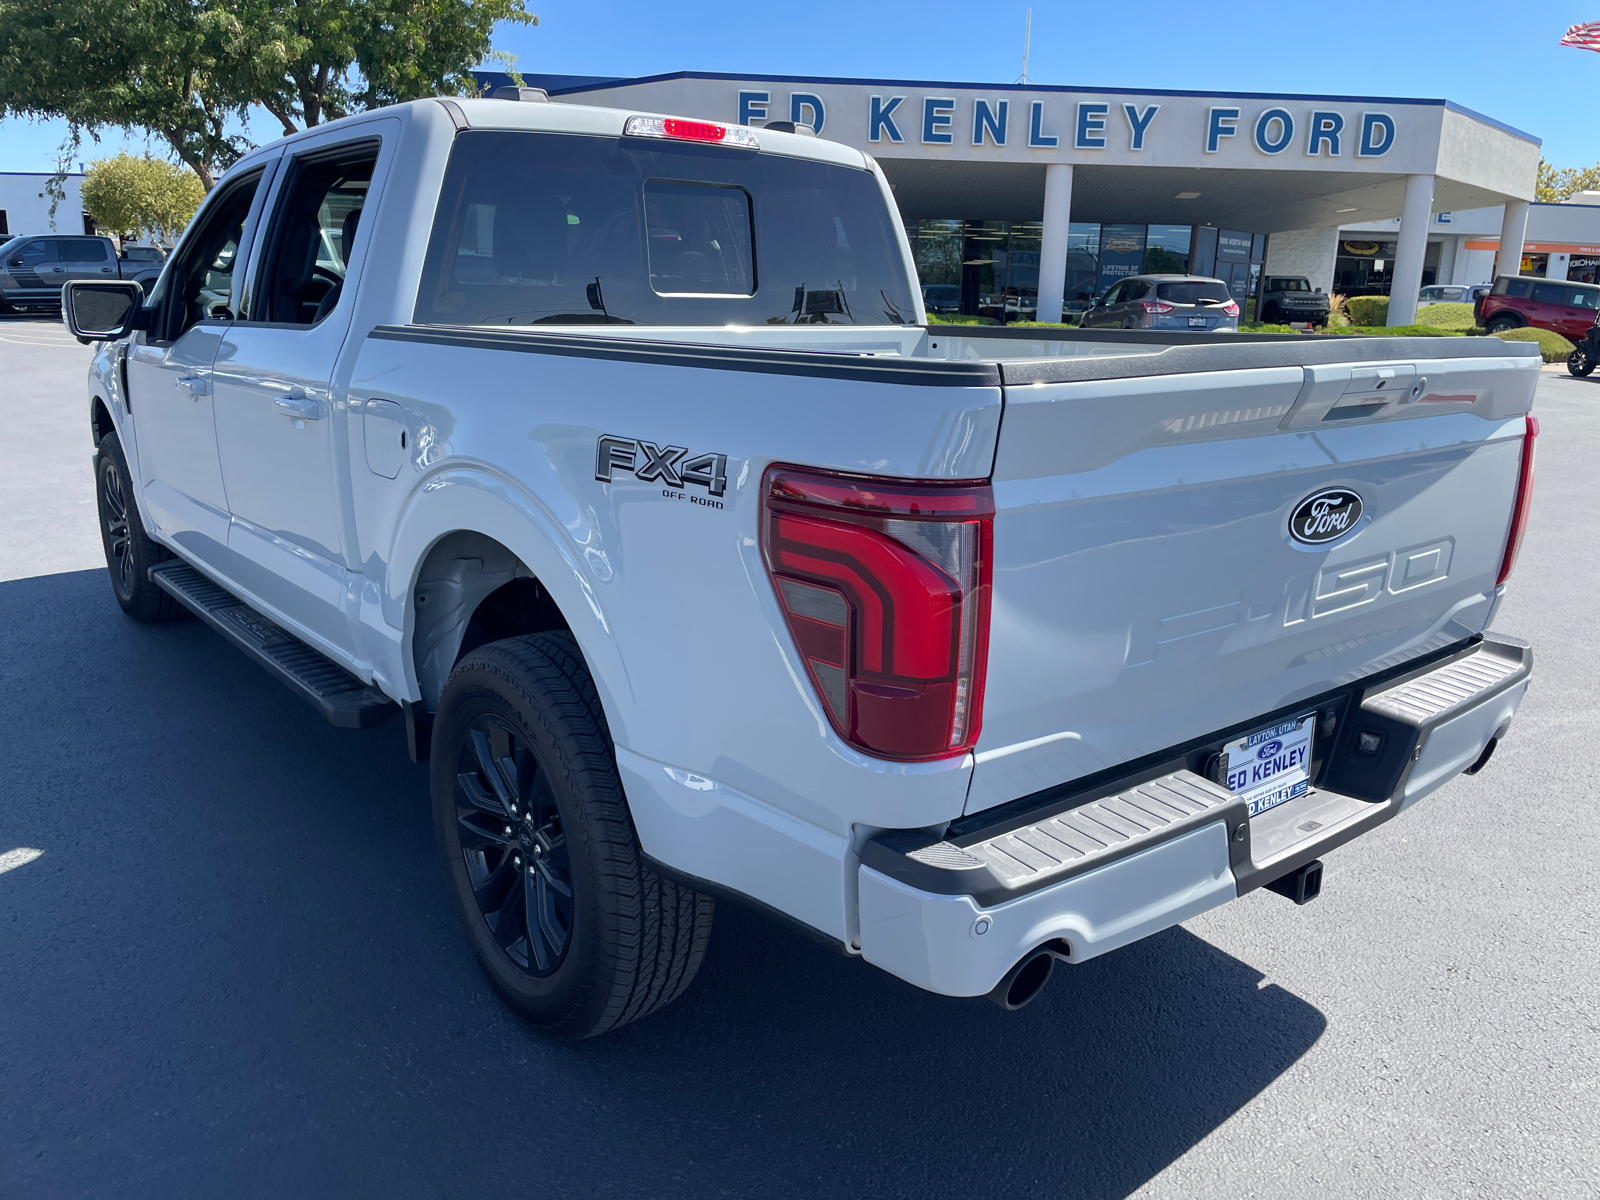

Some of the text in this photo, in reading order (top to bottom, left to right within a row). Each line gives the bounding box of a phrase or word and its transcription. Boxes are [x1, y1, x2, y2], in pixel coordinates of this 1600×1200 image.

[868, 95, 1161, 151] KENLEY
[1205, 106, 1397, 158] FORD
[595, 433, 728, 498] FX4
[662, 489, 724, 510] OFF ROAD
[1302, 496, 1353, 537] Ford
[1123, 534, 1456, 669] F-150
[1278, 720, 1297, 735] UTAH
[1228, 769, 1247, 791] ED
[1252, 745, 1307, 783] KENLEY
[1261, 742, 1279, 758] Ford
[1247, 803, 1256, 815] D
[1257, 786, 1293, 811] KENLEY
